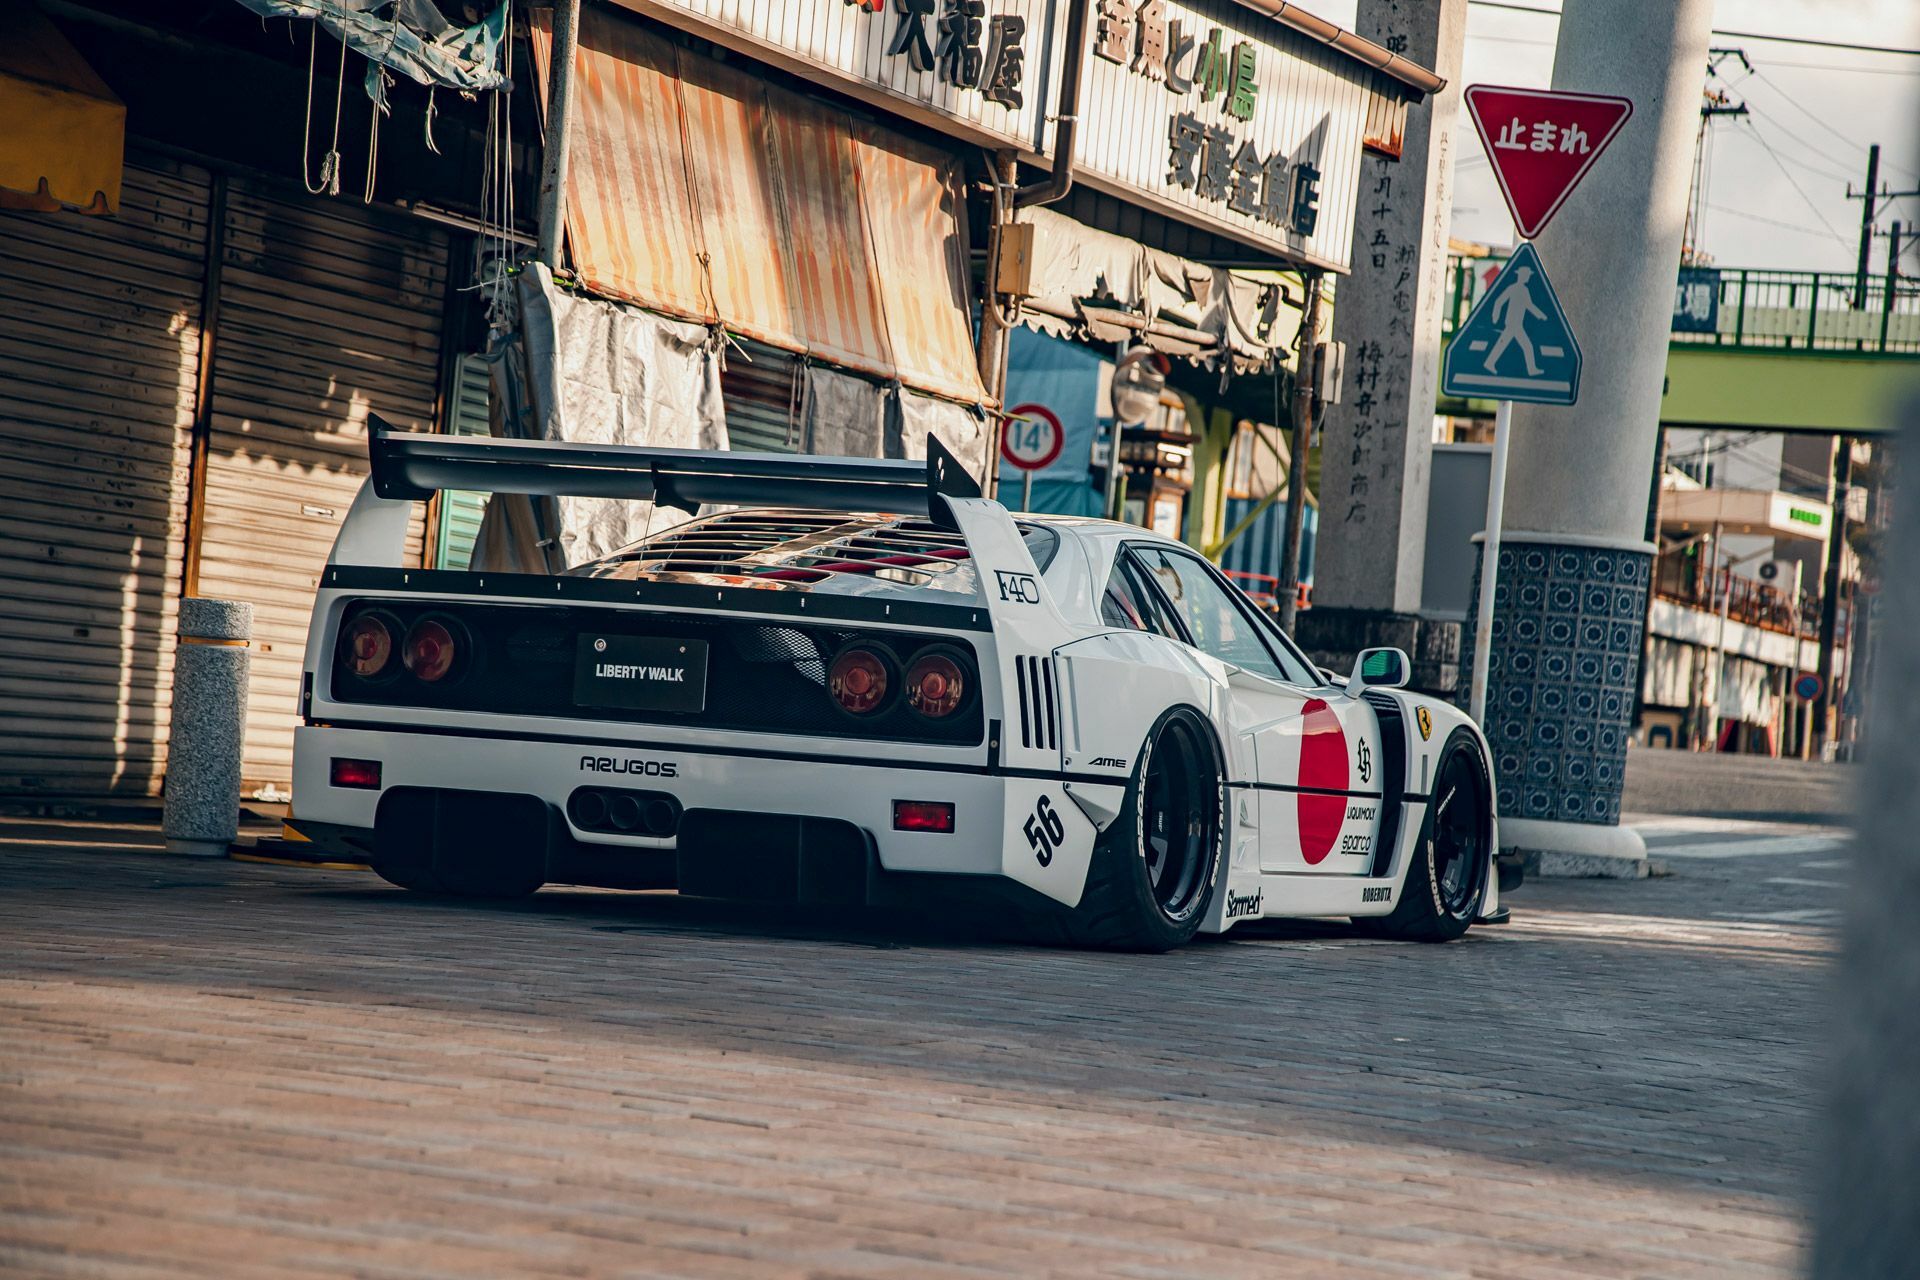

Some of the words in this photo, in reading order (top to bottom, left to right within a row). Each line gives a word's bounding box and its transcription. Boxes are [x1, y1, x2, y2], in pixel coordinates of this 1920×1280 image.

[1494, 116, 1591, 155] 止まれ
[994, 569, 1040, 604] F40
[596, 663, 647, 680] LIBERTY
[648, 666, 684, 682] WALK
[580, 755, 677, 778] ARUGOS
[1088, 757, 1127, 769] AME
[1023, 794, 1065, 868] 56
[1341, 834, 1372, 855] sparco
